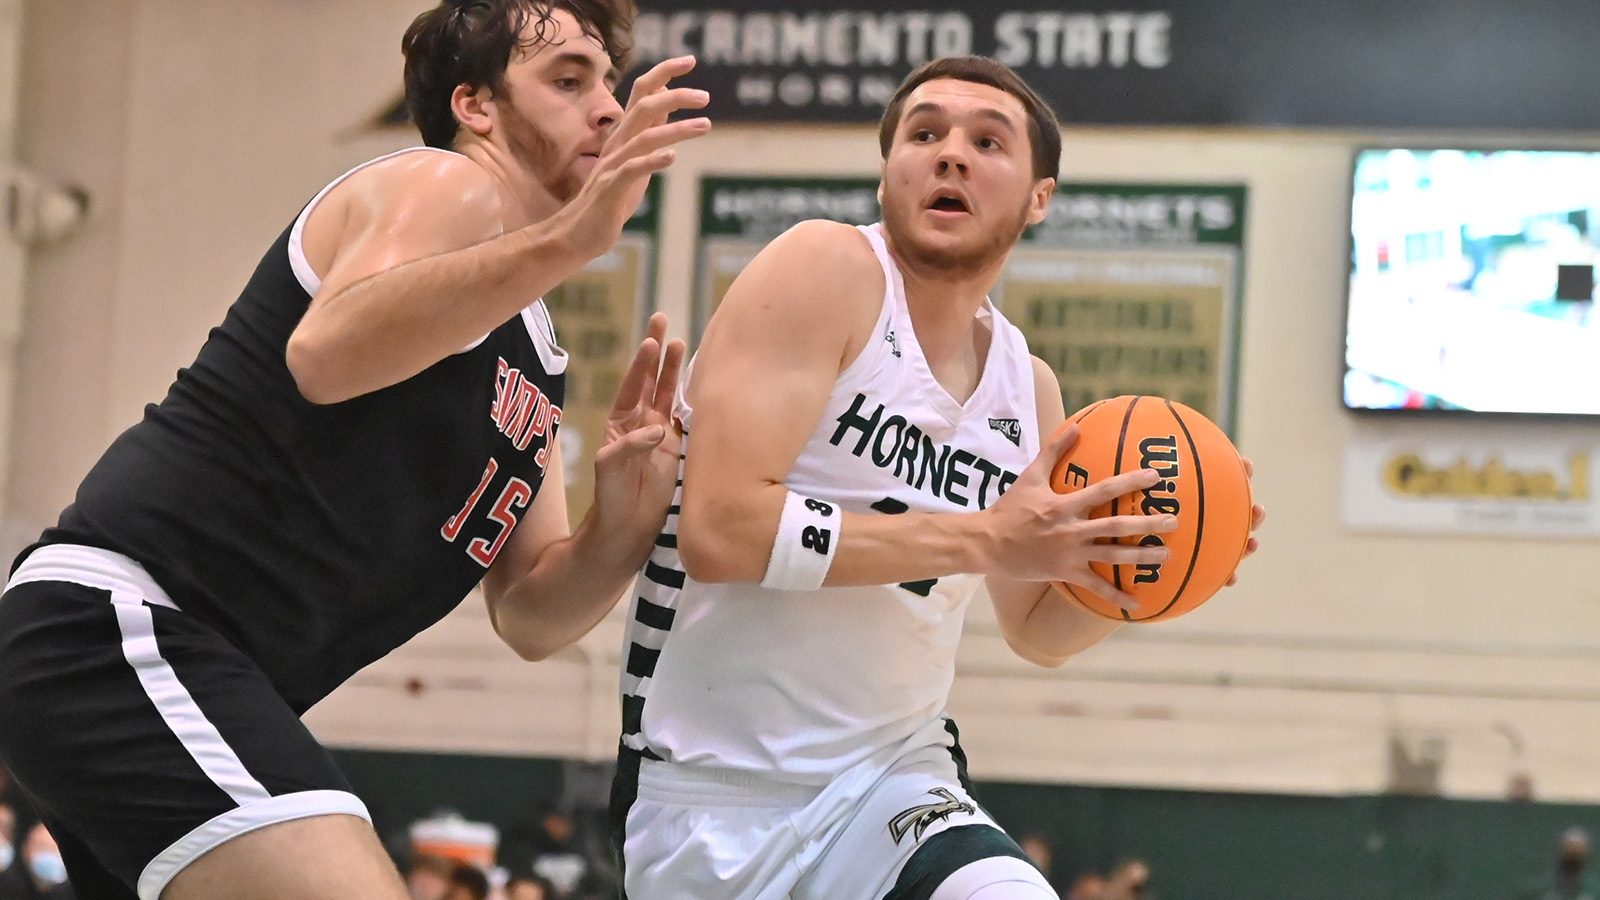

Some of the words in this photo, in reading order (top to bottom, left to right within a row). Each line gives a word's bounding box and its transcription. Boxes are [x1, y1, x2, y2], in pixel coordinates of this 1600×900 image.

[632, 12, 973, 66] ACRAMENTO
[994, 12, 1171, 68] STATE
[736, 73, 898, 106] HORN
[490, 356, 562, 477] SIMPS
[440, 457, 532, 568] 15
[1133, 435, 1180, 585] Wiln
